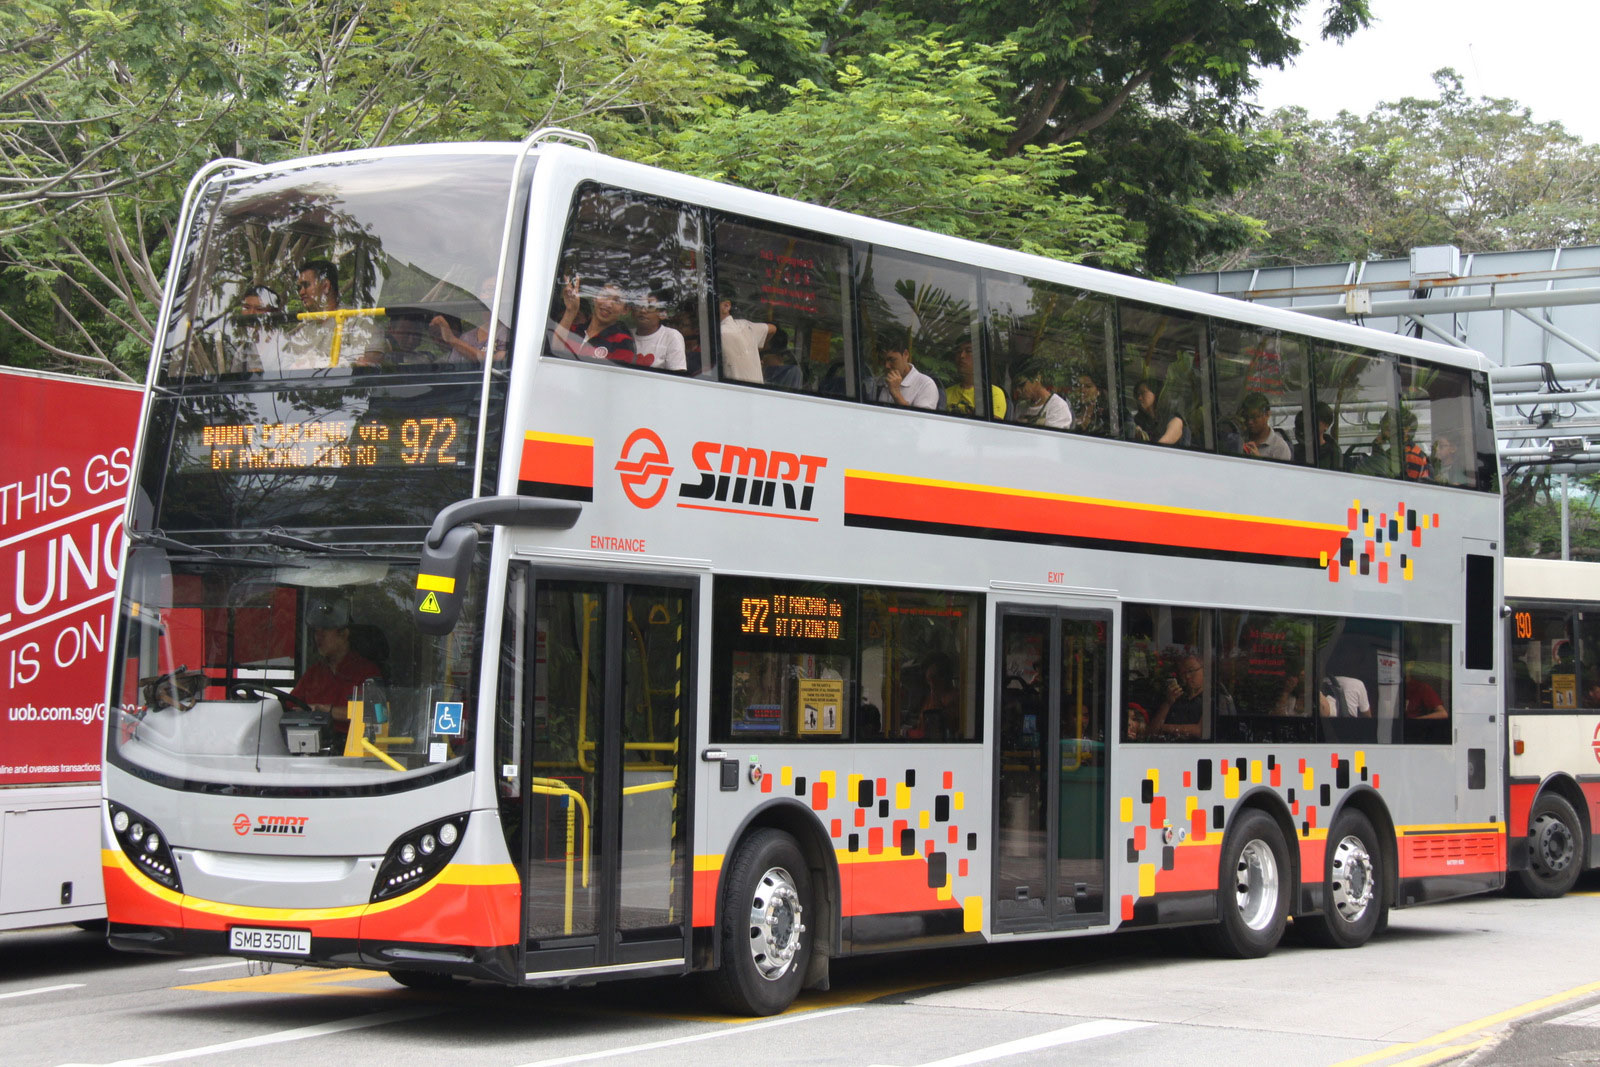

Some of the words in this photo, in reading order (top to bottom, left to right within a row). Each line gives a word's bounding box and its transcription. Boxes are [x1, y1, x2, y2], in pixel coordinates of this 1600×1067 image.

[203, 424, 257, 446] BUKIT
[263, 422, 347, 443] PANJANG
[359, 420, 389, 440] via
[401, 418, 457, 463] 972
[212, 449, 234, 469] BT
[357, 445, 377, 465] RD
[679, 440, 828, 511] SMRT
[0, 467, 71, 525] THIS
[590, 535, 646, 553] ENTRANCE
[1047, 571, 1065, 584] EXIT
[741, 598, 769, 634] 972
[774, 595, 787, 614] BT
[775, 618, 788, 637] BT
[1515, 611, 1532, 639] 190
[9, 642, 41, 690] IS
[54, 614, 106, 668] ON
[14, 764, 29, 773] and
[29, 765, 60, 773] overseas
[253, 815, 309, 834] SMRT
